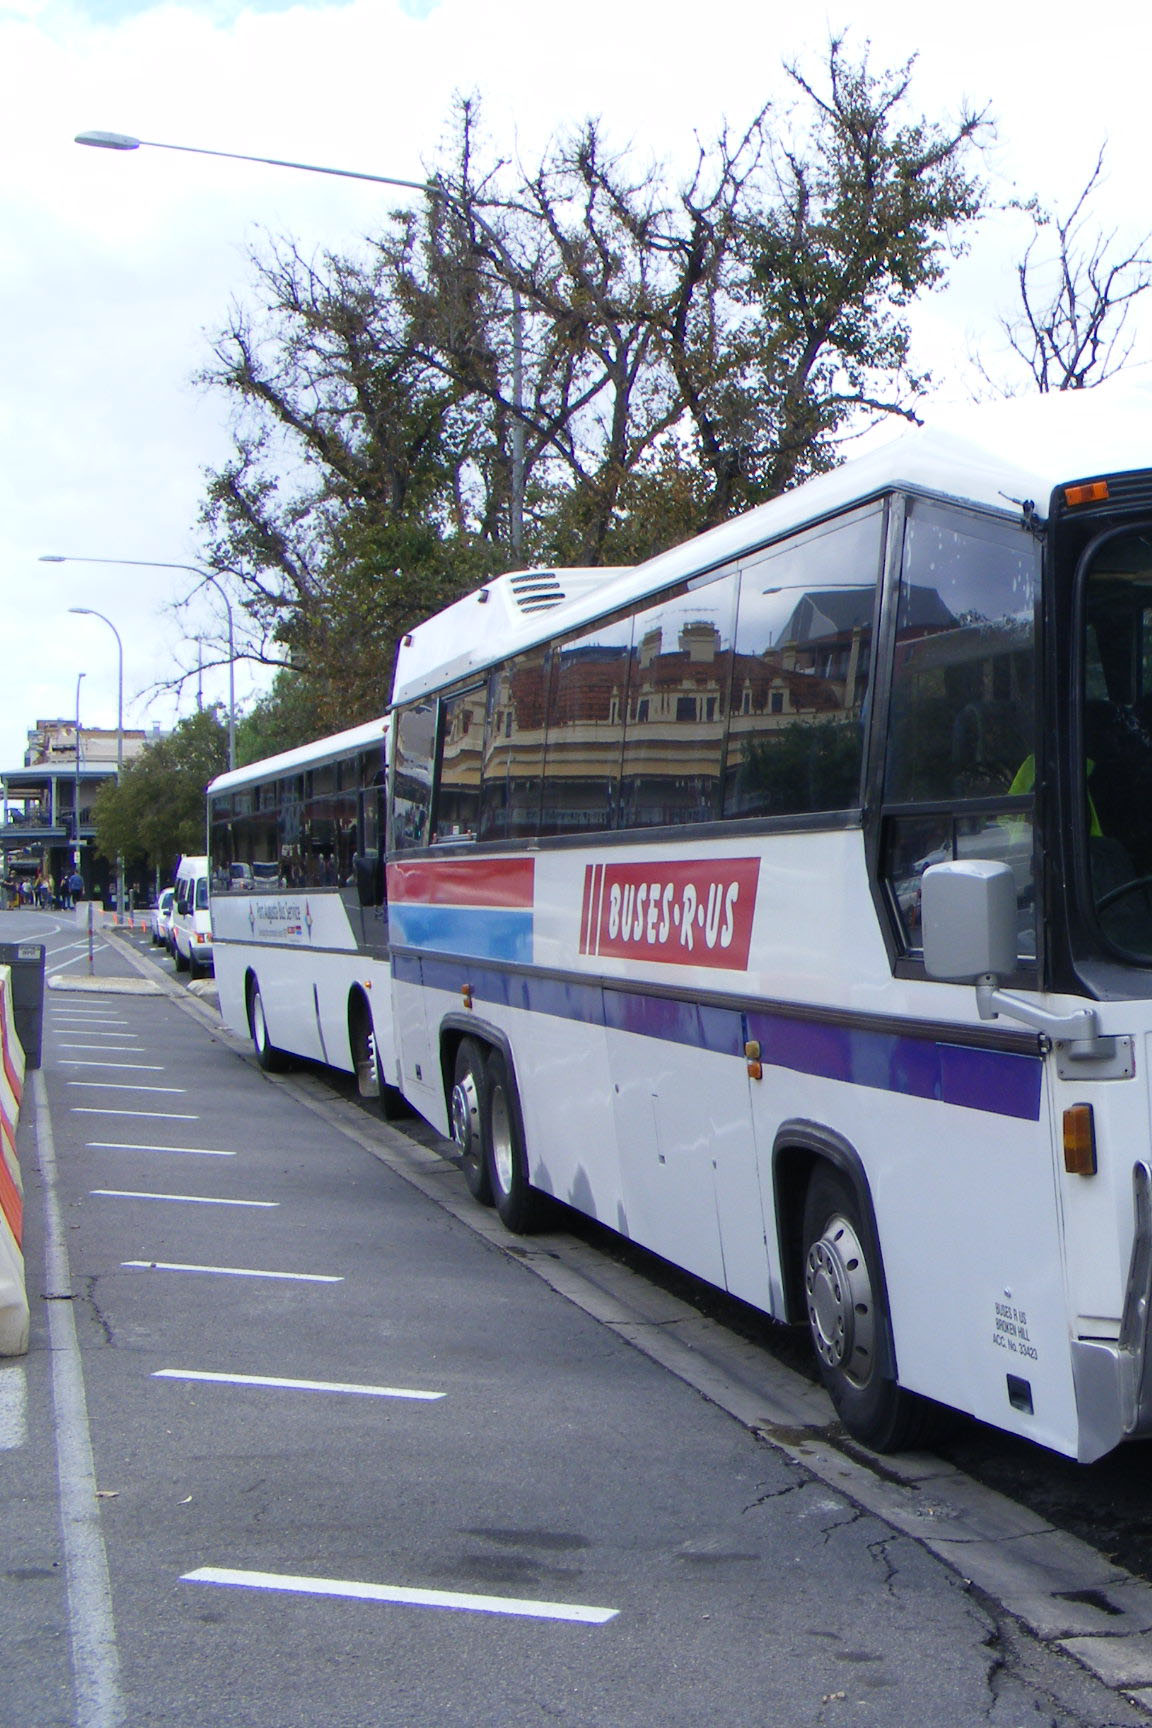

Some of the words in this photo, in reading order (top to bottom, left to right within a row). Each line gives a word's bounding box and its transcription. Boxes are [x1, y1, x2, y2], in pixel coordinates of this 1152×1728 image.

[995, 1302, 1013, 1320] BUSES
[1013, 1308, 1018, 1322] R
[1018, 1311, 1027, 1325] US
[995, 1318, 1018, 1338] BROKEN
[1017, 1326, 1031, 1342] HILL
